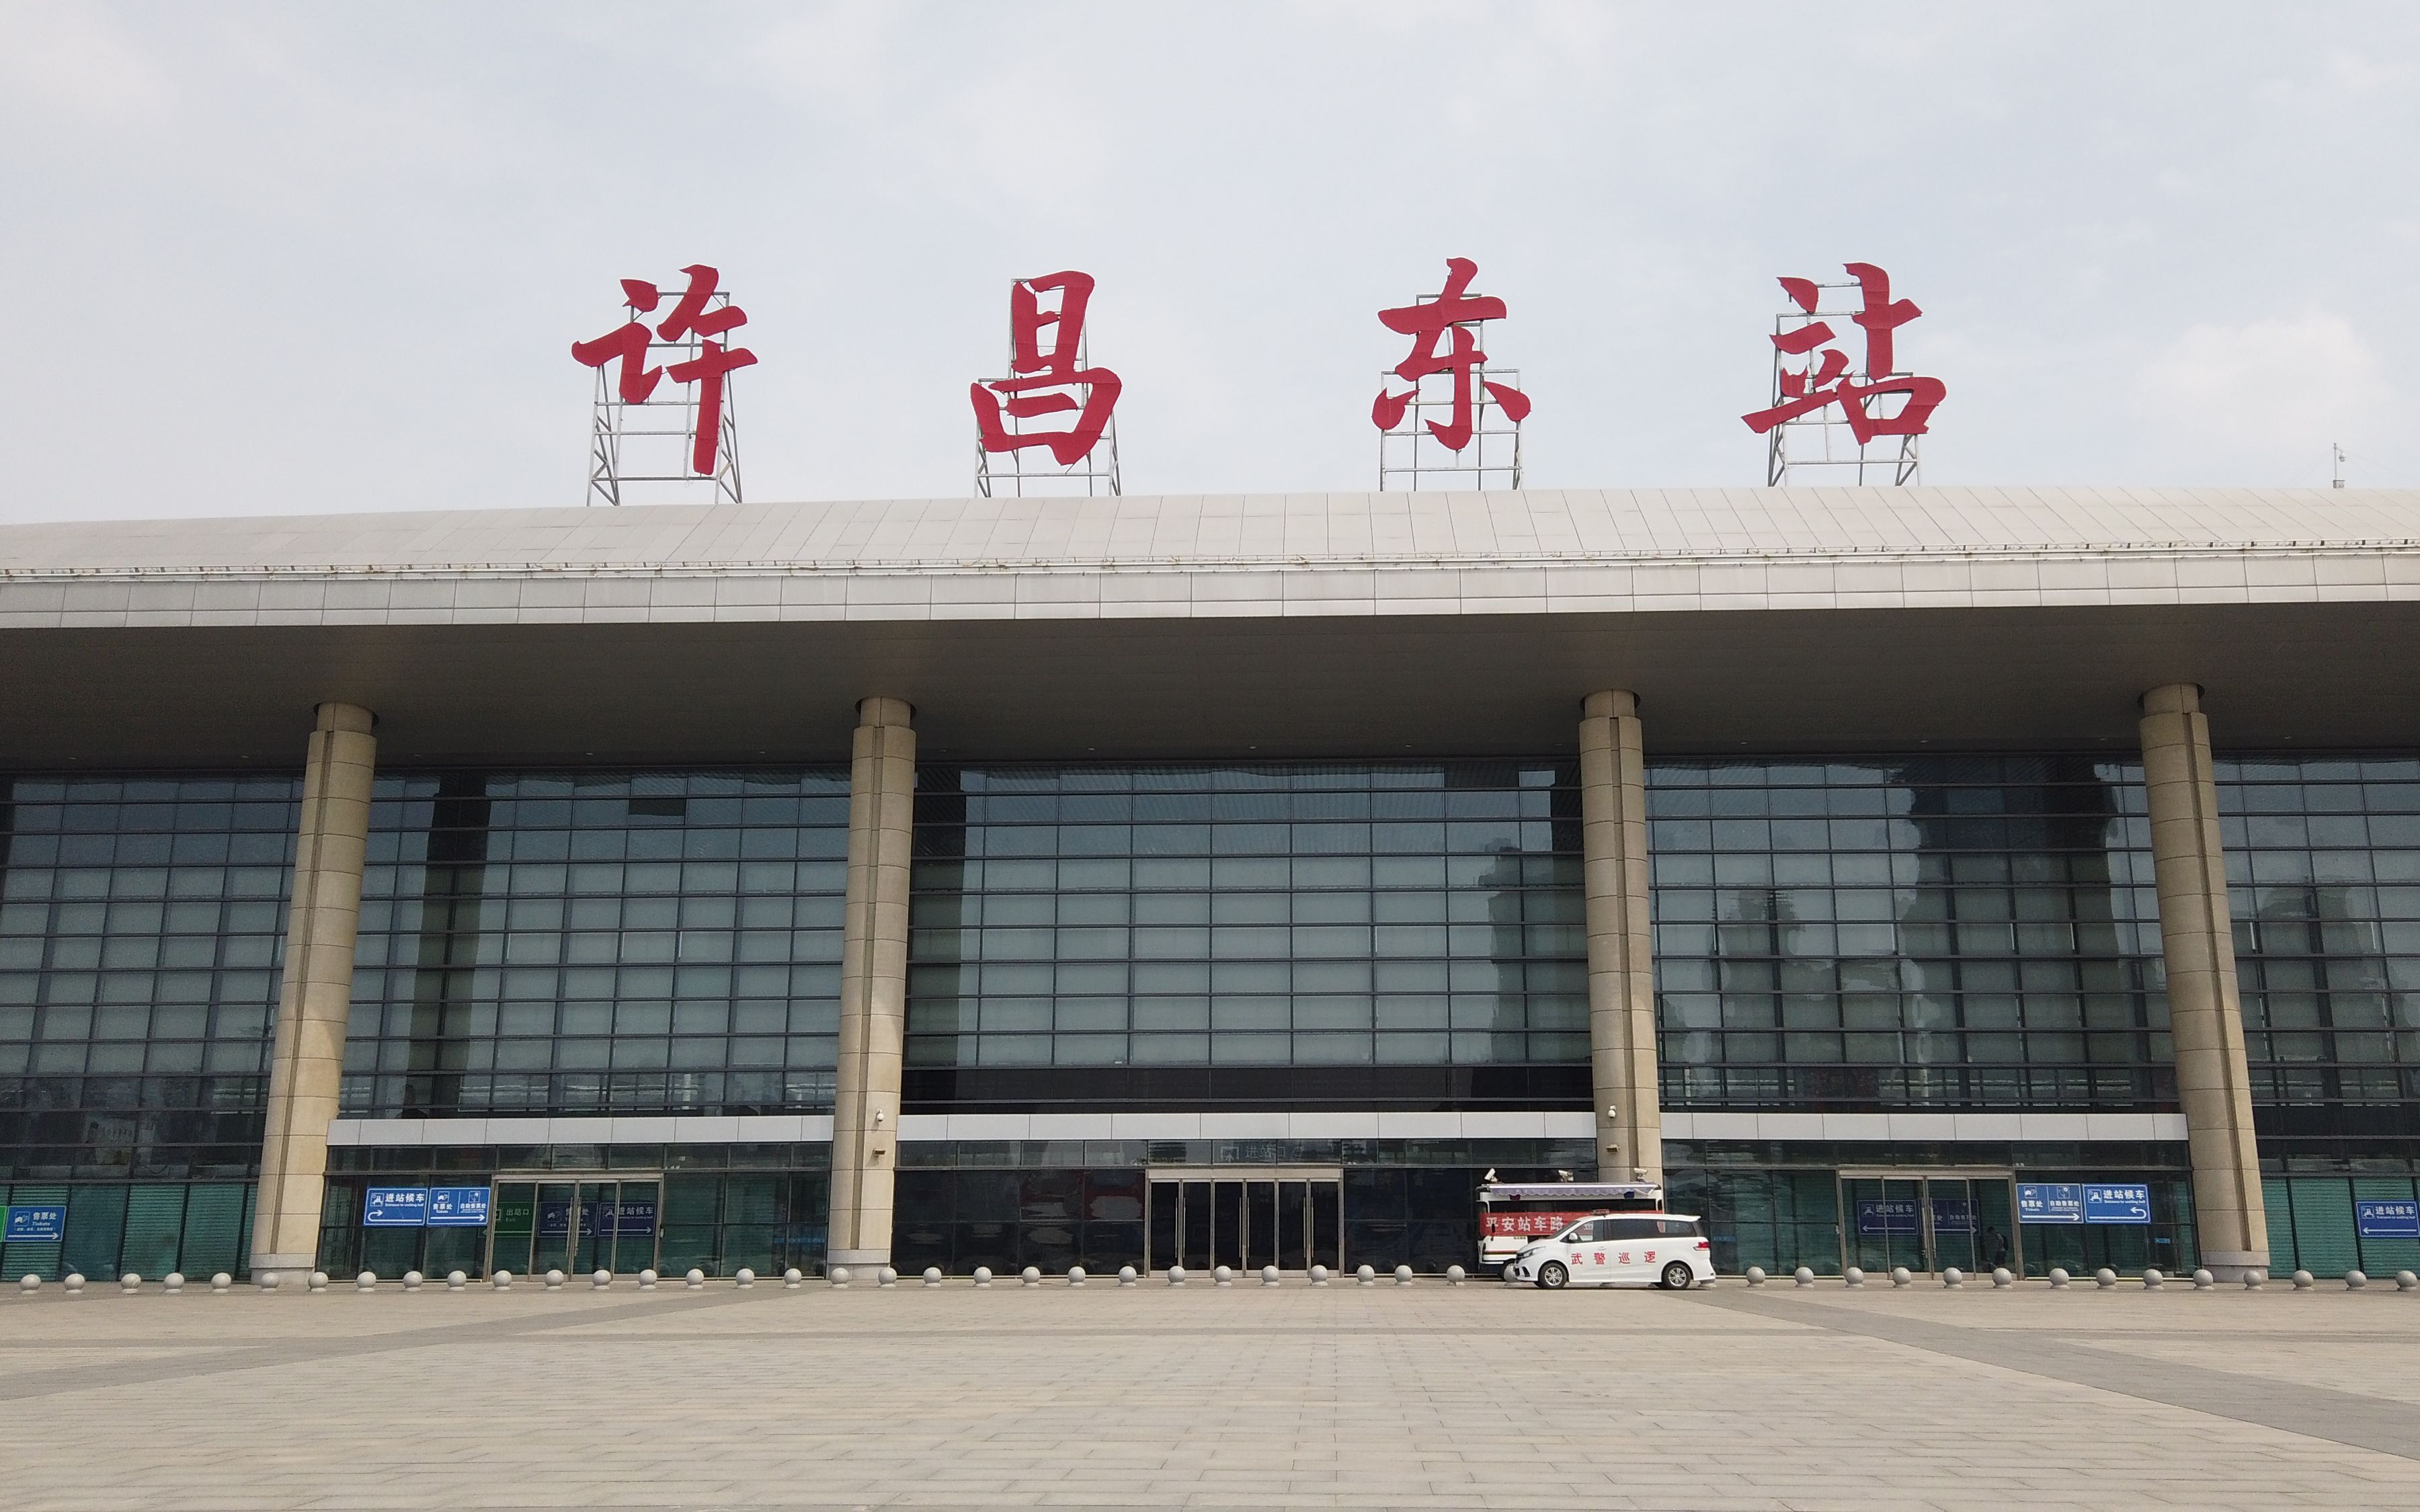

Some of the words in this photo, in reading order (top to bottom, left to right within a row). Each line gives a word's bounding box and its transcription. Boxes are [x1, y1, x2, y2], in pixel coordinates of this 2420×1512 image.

[572, 258, 1945, 474] 许昌东站
[385, 1193, 425, 1202] 进站候车
[2103, 1189, 2145, 1199] 进站候车
[506, 1208, 529, 1216] 出站口
[2375, 1206, 2415, 1215] 进站候车
[33, 1212, 56, 1220] 售票处
[1571, 1251, 1656, 1265] 武警巡逻
